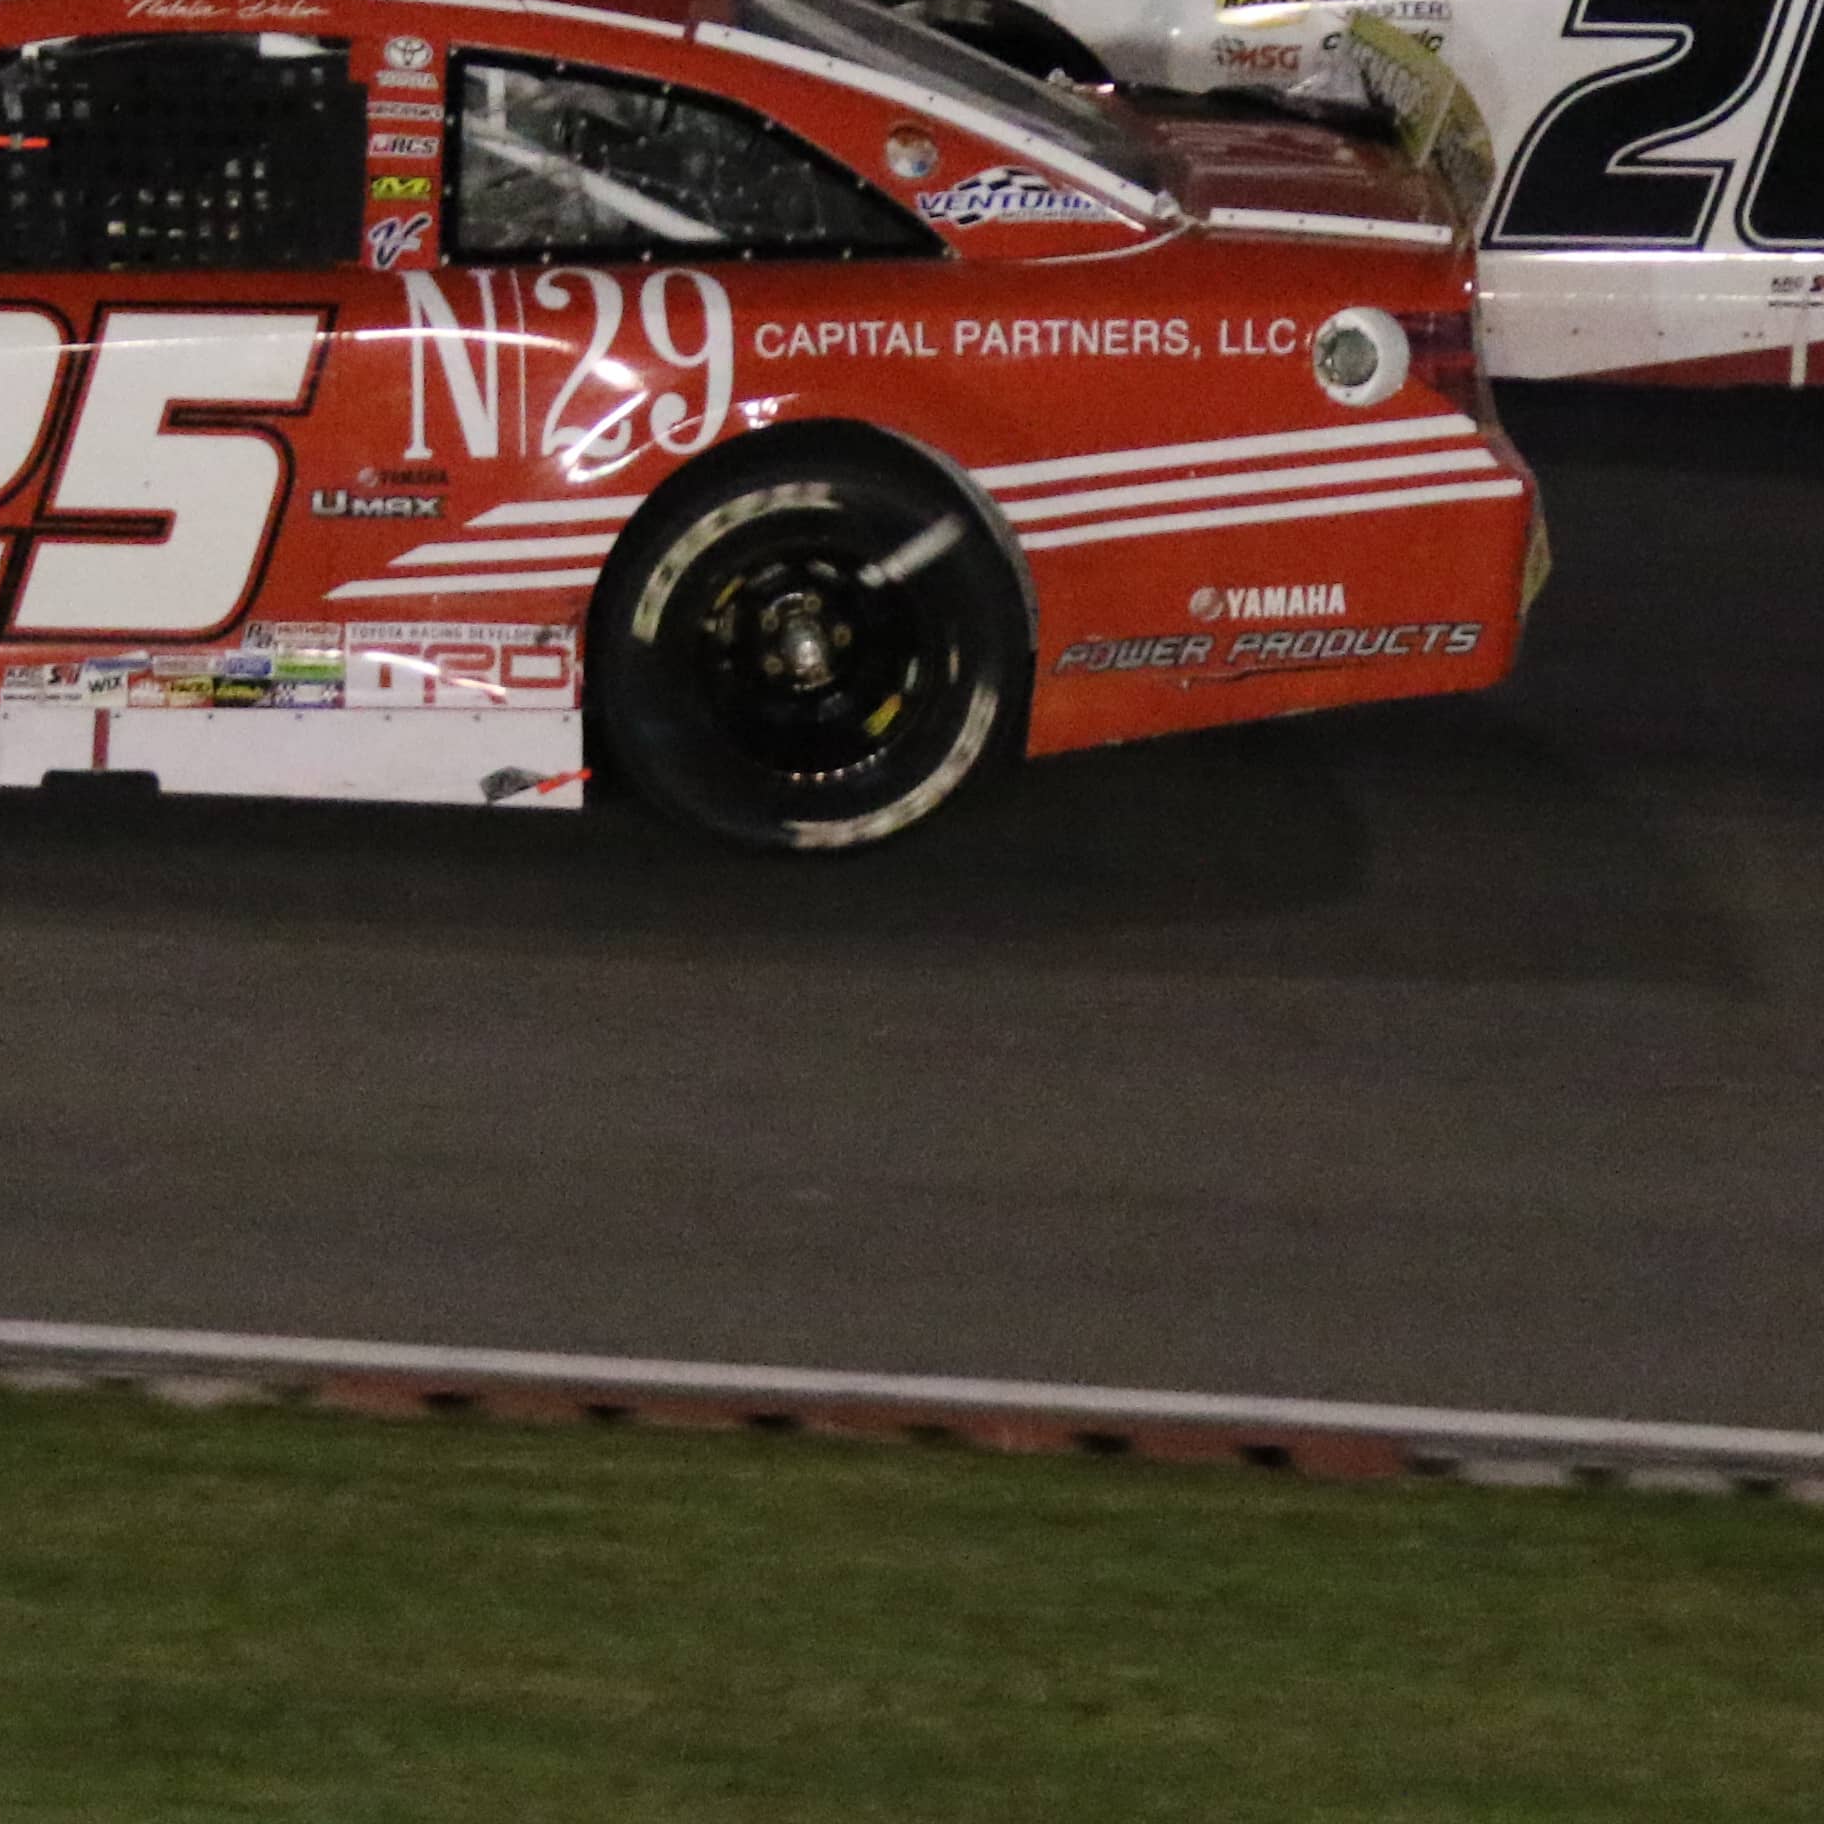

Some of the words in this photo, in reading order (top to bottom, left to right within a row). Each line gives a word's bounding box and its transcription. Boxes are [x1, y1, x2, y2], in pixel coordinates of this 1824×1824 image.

[754, 322, 937, 359] CAPITAL
[955, 318, 1202, 361] PARTNERS,
[1218, 318, 1297, 353] LLC
[1225, 583, 1347, 619] YAMAHA
[1053, 633, 1215, 675] POWER
[1226, 623, 1482, 663] PRODUCTS
[348, 642, 571, 704] TRD
